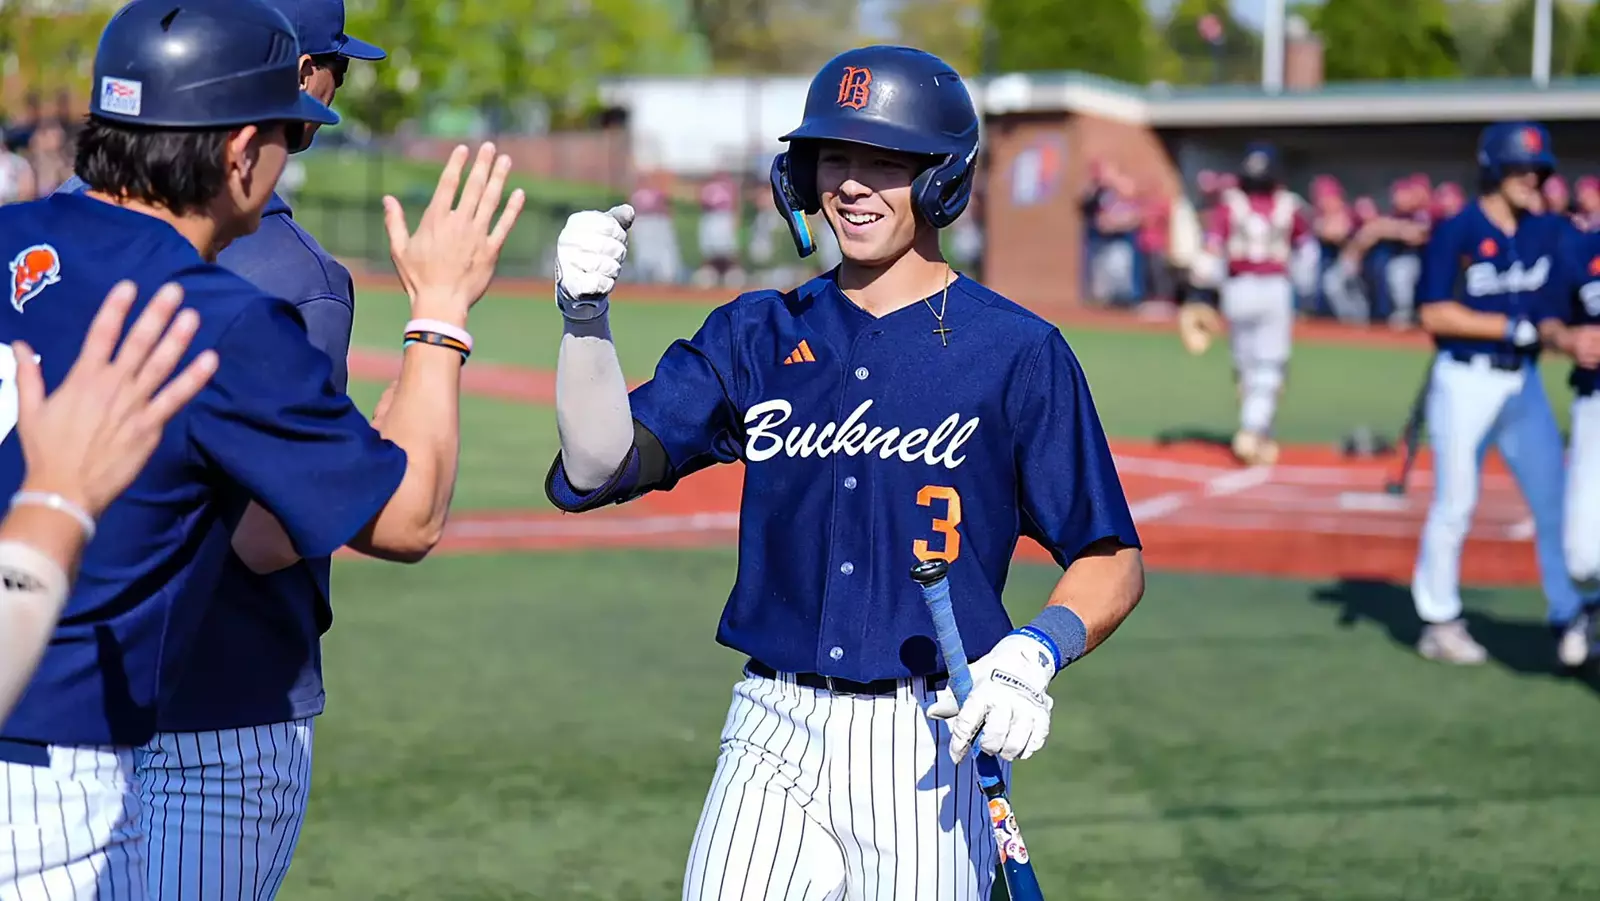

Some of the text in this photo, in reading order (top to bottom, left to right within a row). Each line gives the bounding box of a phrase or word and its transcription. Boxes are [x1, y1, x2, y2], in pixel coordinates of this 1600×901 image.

[836, 66, 872, 111] B
[744, 398, 980, 469] Bucknell
[913, 485, 962, 564] 3
